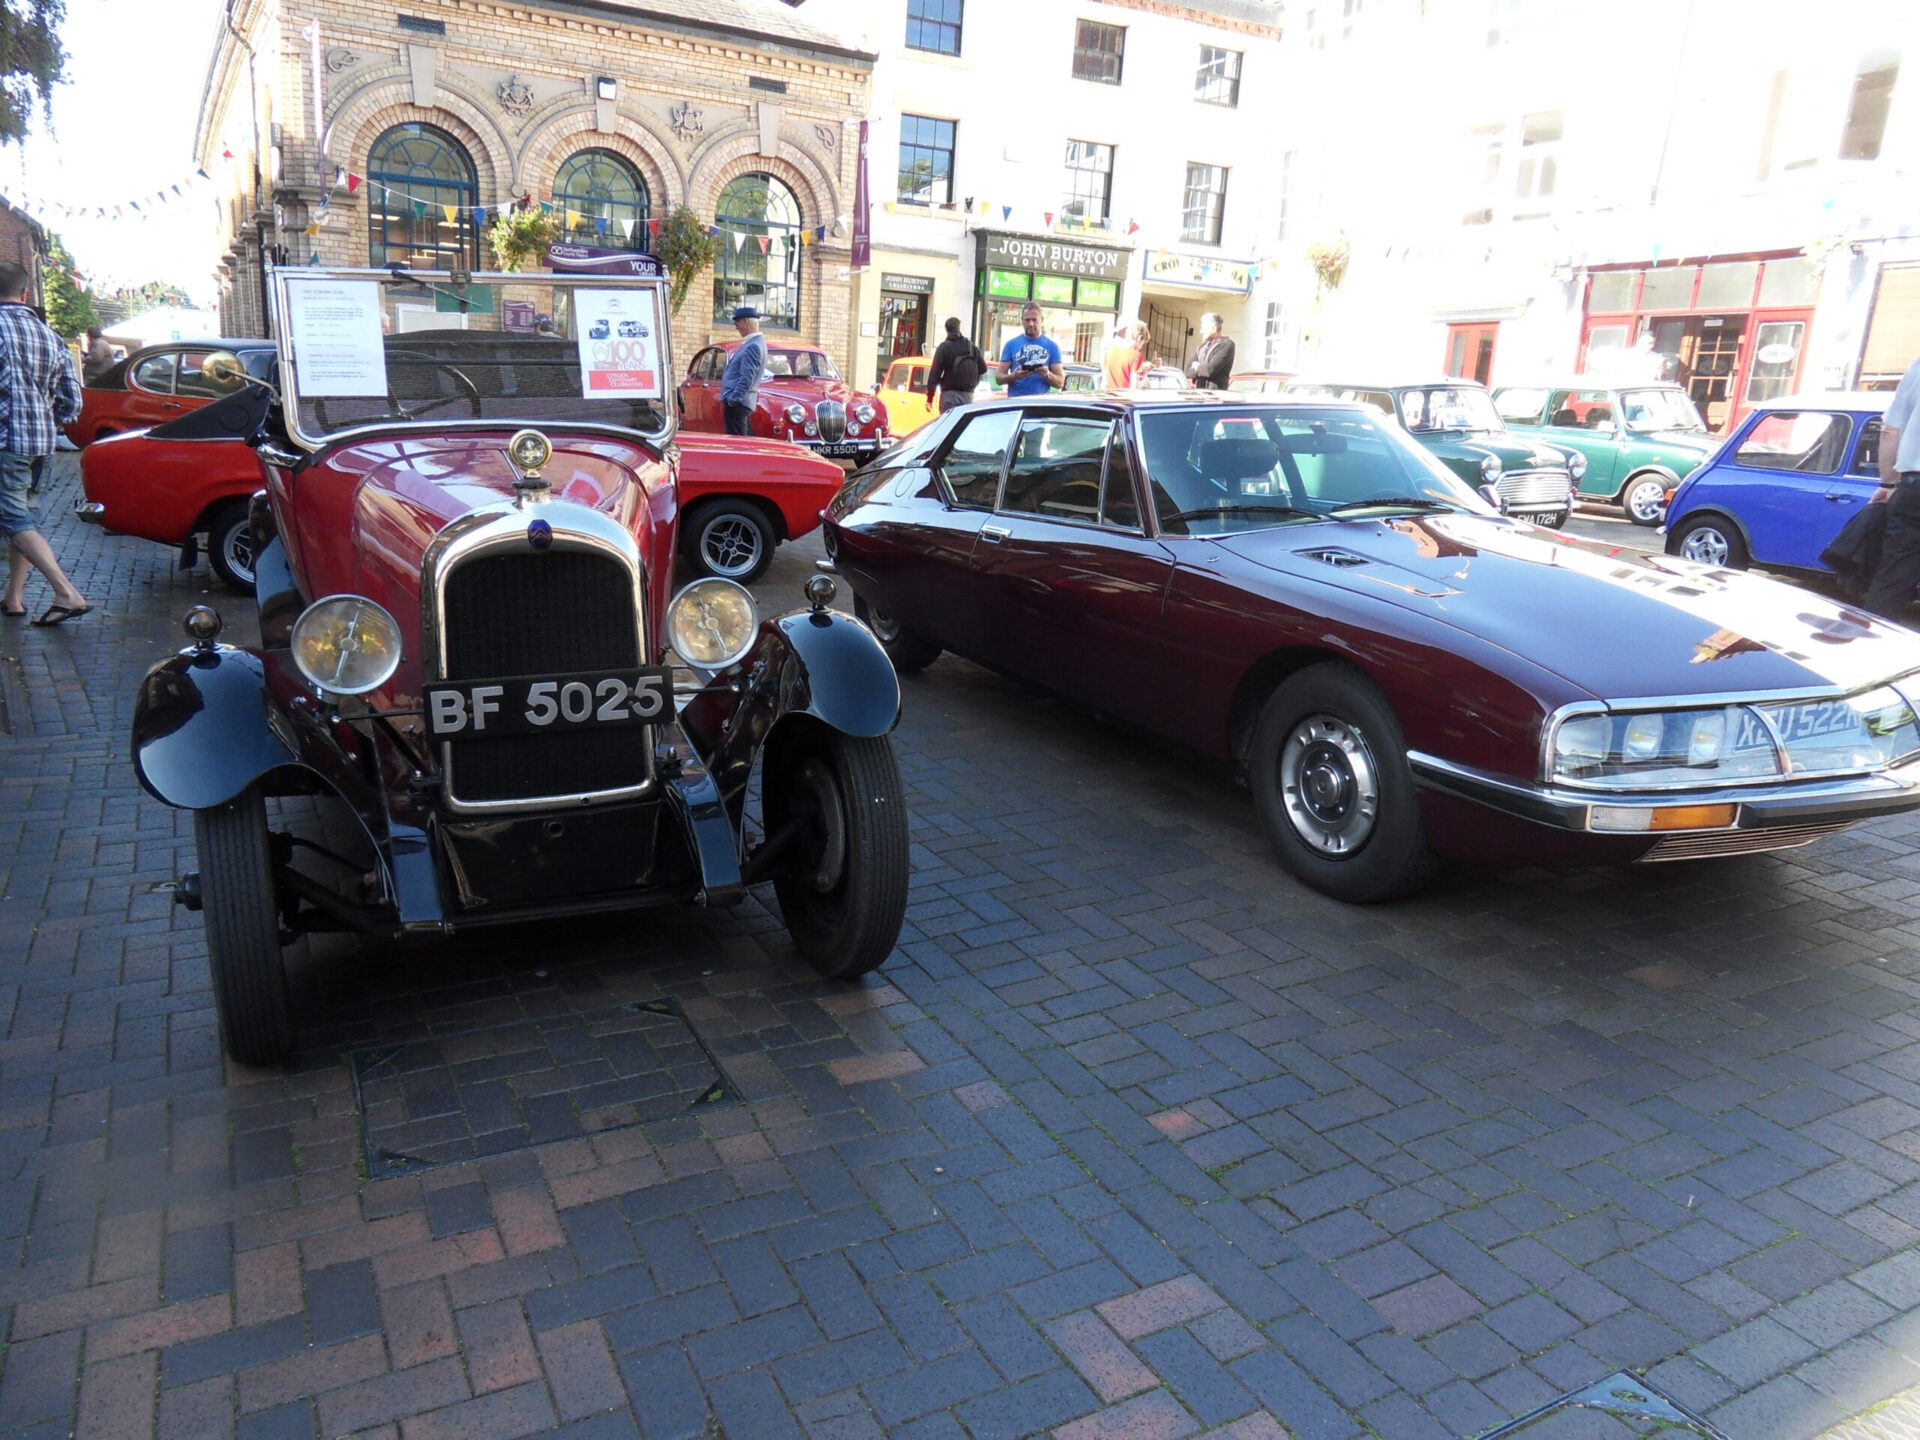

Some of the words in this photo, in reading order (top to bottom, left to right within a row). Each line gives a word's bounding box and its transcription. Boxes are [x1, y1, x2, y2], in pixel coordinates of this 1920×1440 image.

[999, 239, 1046, 259] JOHN
[1050, 245, 1119, 268] BURTON
[630, 260, 657, 272] YOUR
[1012, 256, 1106, 276] SOLICITORS
[885, 275, 903, 283] JOHN
[903, 277, 929, 286] BURTON
[608, 340, 646, 362] 100
[617, 361, 646, 370] YEARS
[813, 446, 832, 455] HKR
[1537, 512, 1558, 525] 172H
[429, 685, 504, 734] BF
[523, 674, 664, 727] 5025
